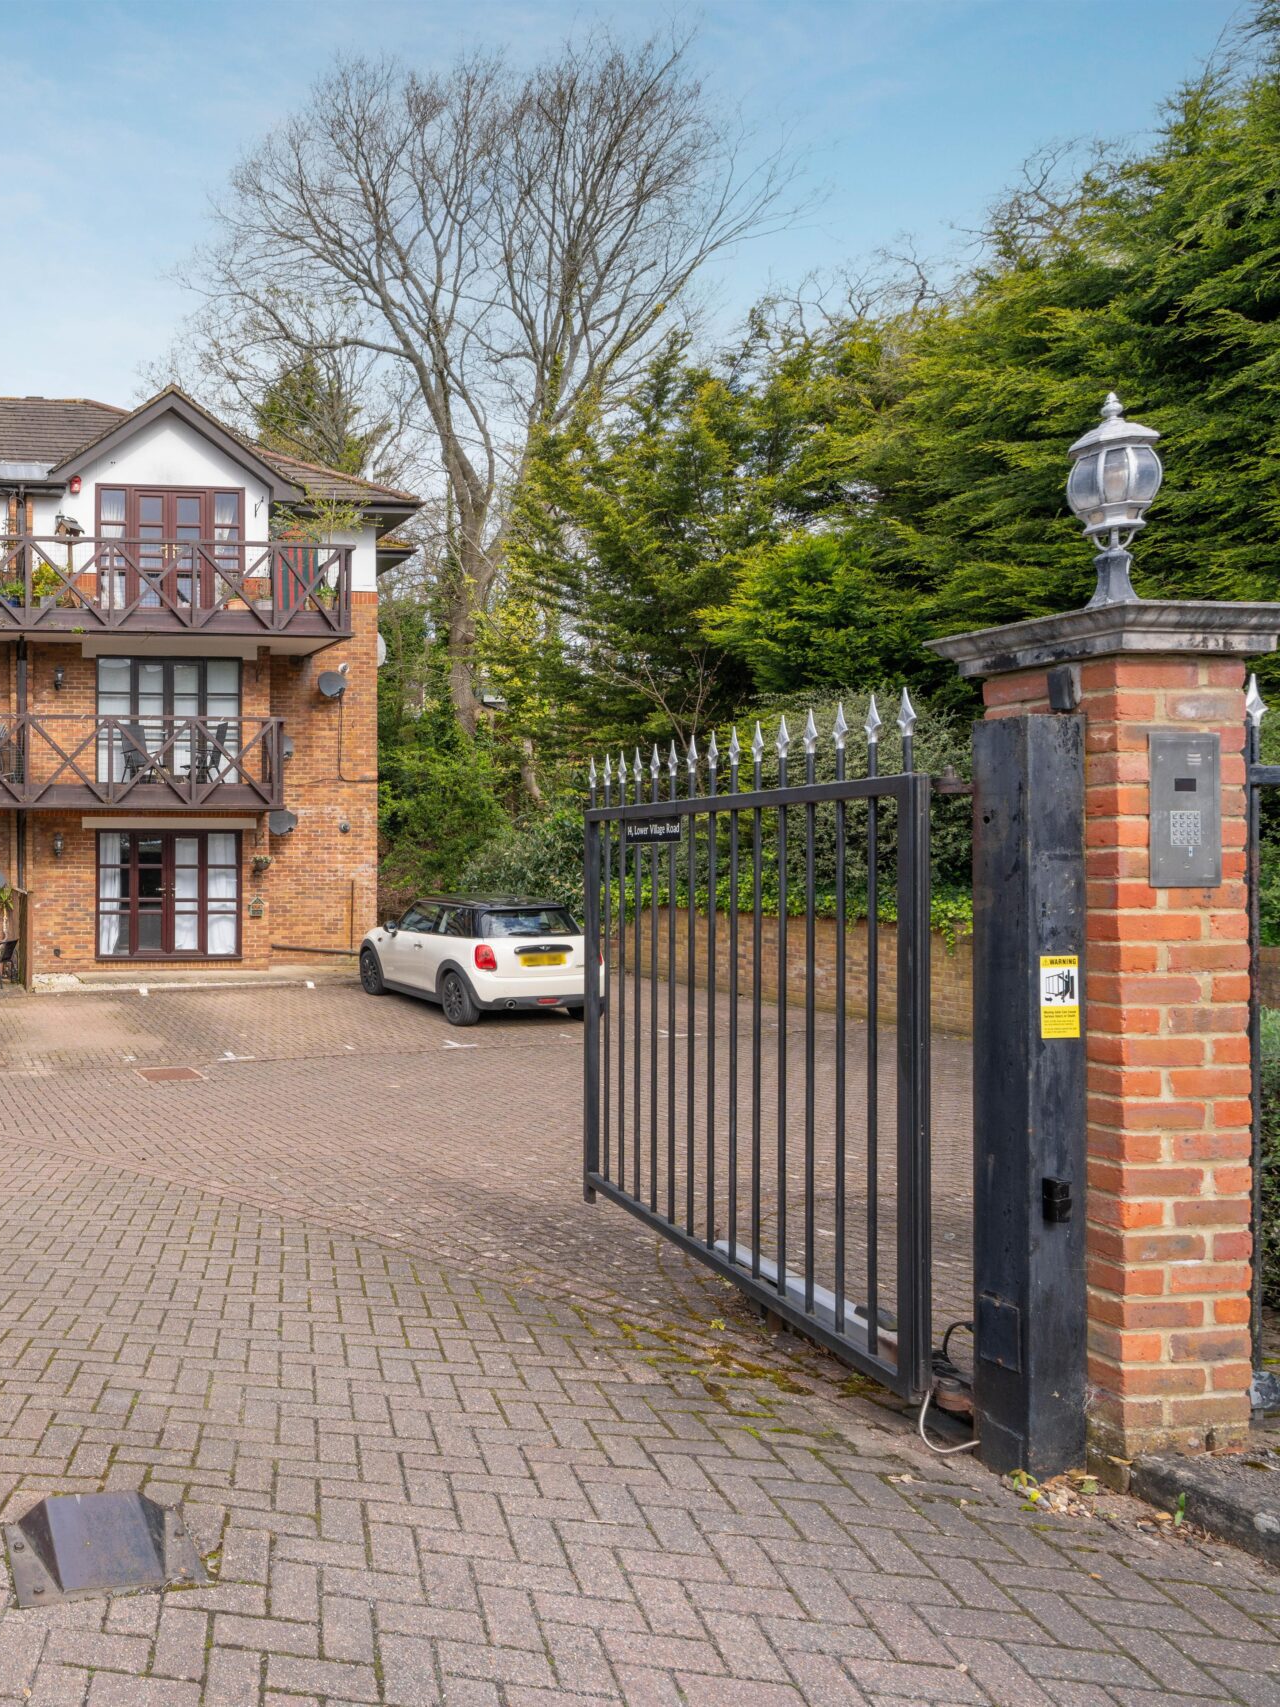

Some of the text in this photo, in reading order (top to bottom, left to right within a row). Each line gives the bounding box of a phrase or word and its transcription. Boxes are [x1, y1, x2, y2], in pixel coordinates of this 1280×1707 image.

[634, 825, 649, 835] Lower
[649, 824, 665, 836] Village
[666, 822, 680, 833] Road
